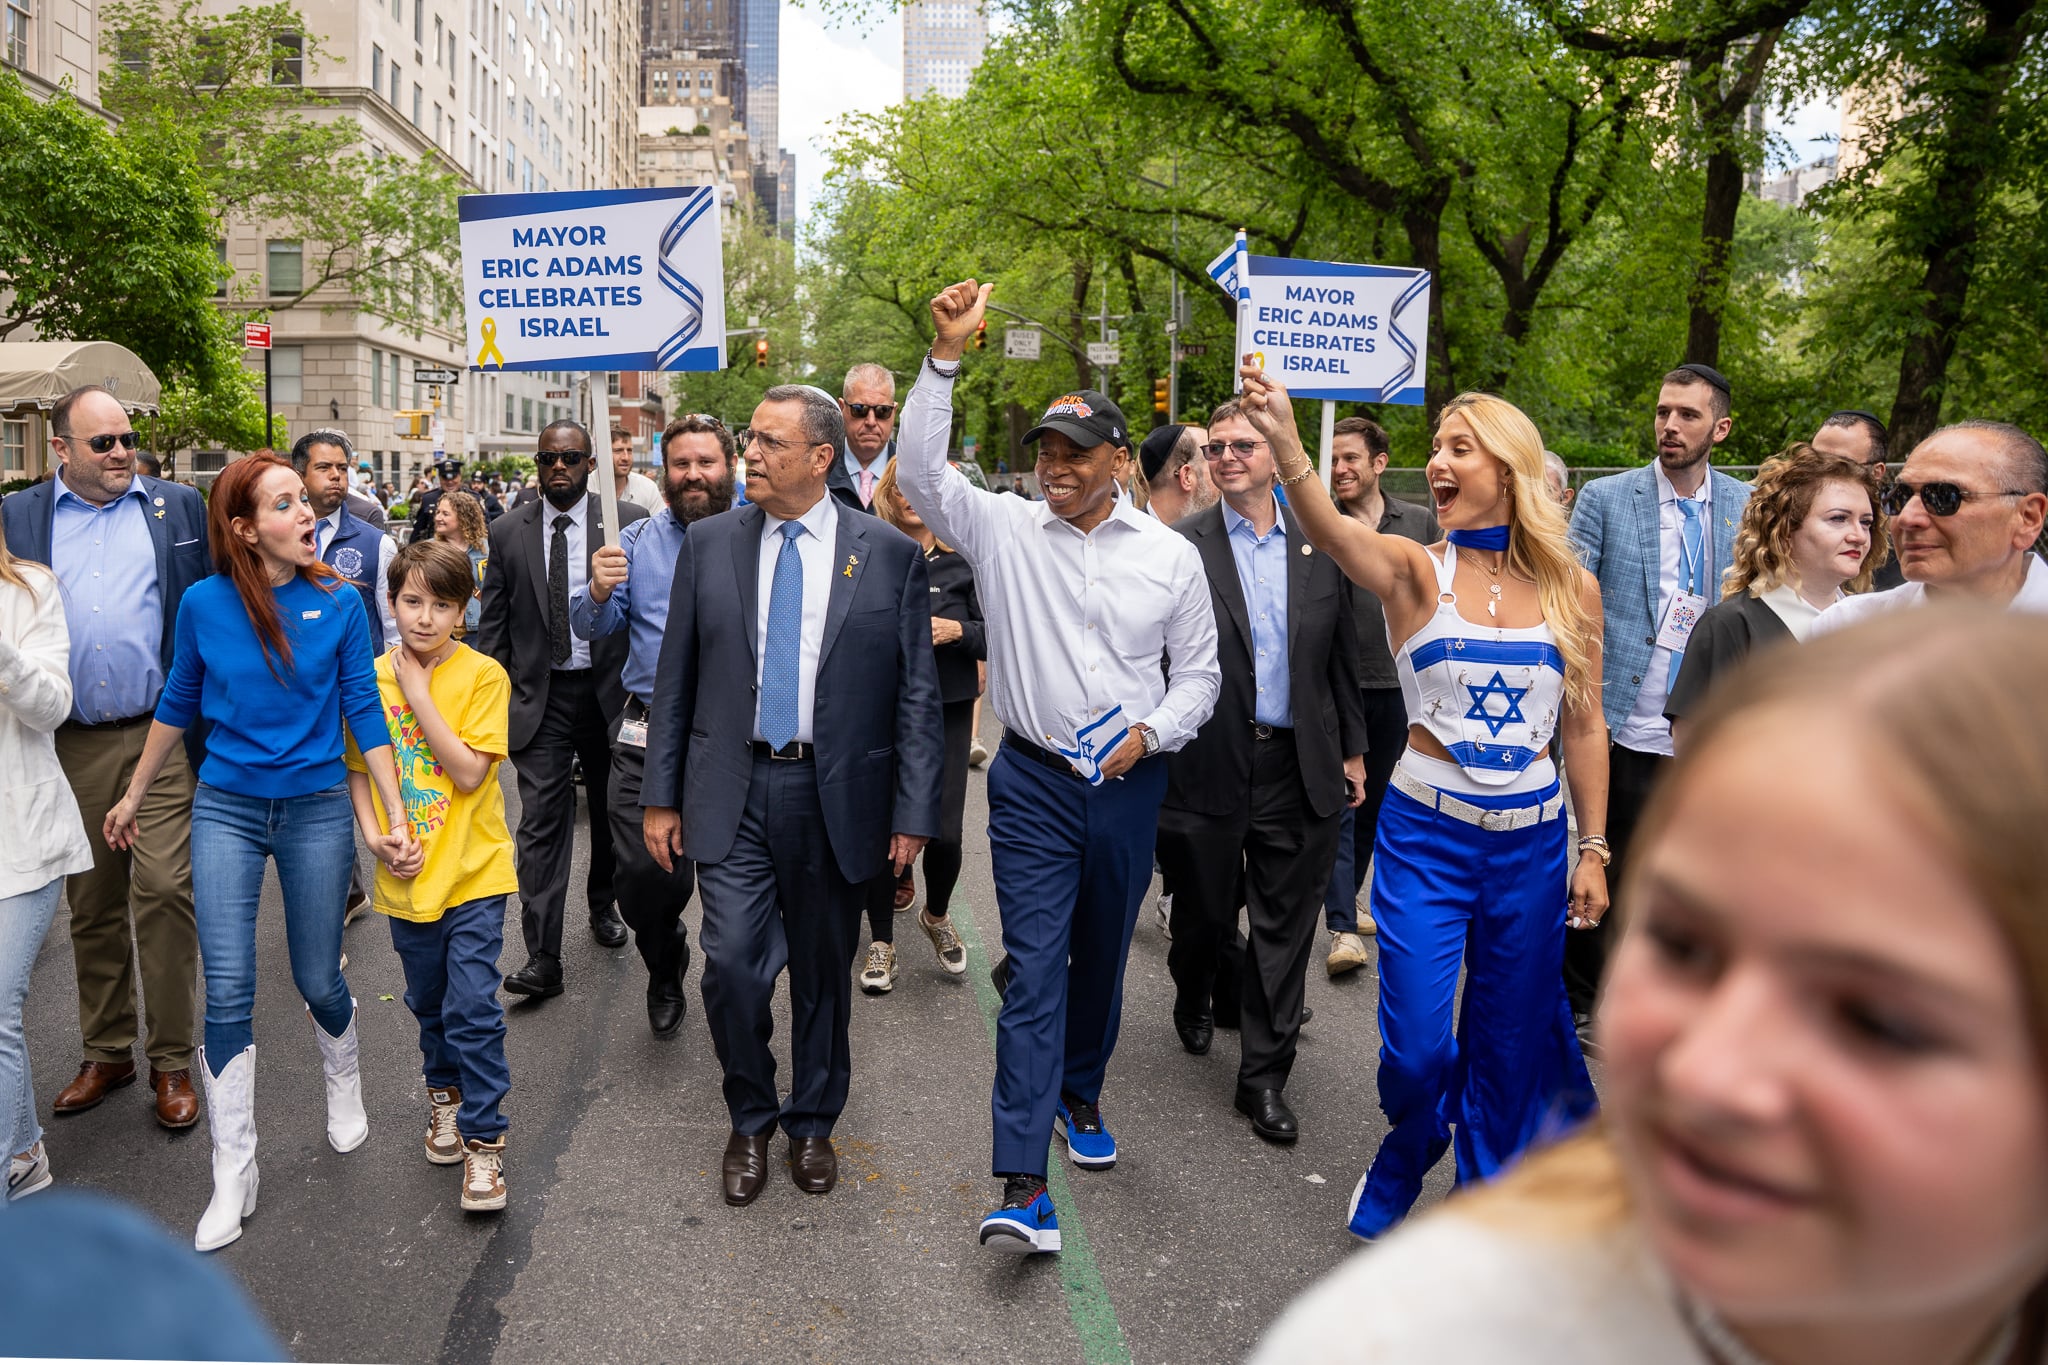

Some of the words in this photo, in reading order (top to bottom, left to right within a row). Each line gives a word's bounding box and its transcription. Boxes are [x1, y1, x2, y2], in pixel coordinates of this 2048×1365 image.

[512, 225, 607, 248] MAYOR
[482, 257, 539, 279] ERIC
[546, 255, 643, 277] ADAMS
[478, 286, 643, 309] CELEBRATES
[1285, 285, 1355, 306] MAYOR
[519, 317, 610, 337] ISRAEL
[1258, 306, 1303, 325] ERIC
[1308, 311, 1378, 331] ADAMS
[1011, 331, 1036, 339] BUSES
[1013, 339, 1032, 347] ONLY
[1253, 329, 1376, 353] CELEBRATES
[1283, 355, 1350, 375] ISRAEL
[929, 585, 941, 593] ain
[407, 796, 451, 822] KVAH
